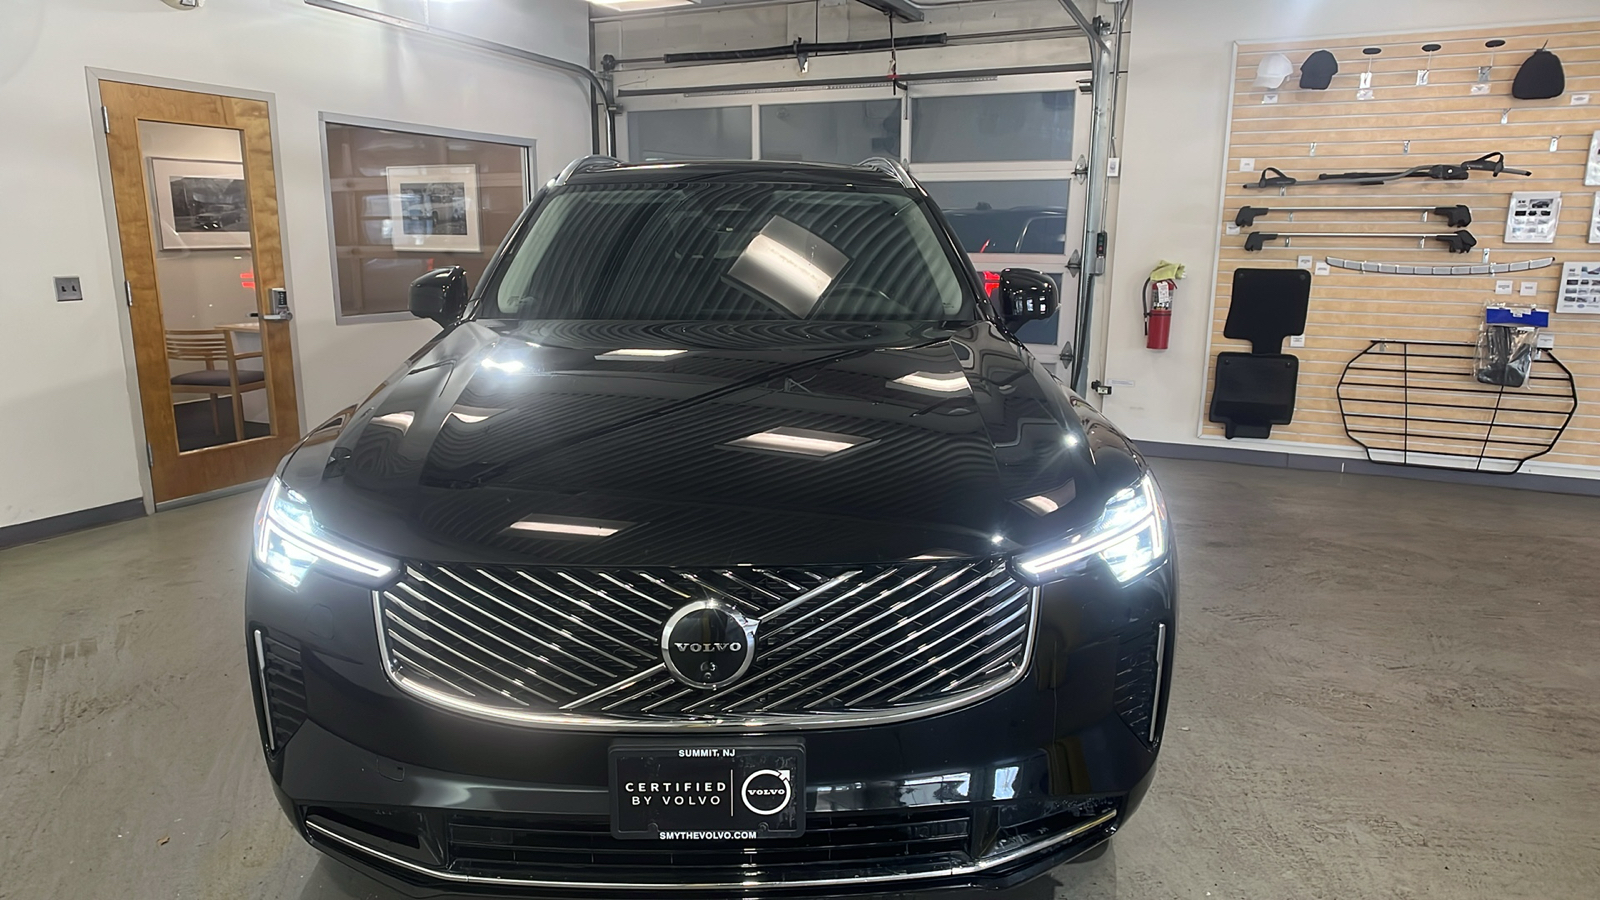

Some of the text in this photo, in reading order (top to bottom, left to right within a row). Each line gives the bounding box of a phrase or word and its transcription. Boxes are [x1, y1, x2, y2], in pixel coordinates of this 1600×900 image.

[674, 642, 742, 652] VOLVO
[678, 749, 736, 757] SUMMIT, NJ
[625, 782, 726, 792] CERTIFIED
[632, 796, 721, 805] BY VOLVO
[659, 831, 757, 840] SMYTHEVOLVO.COM
